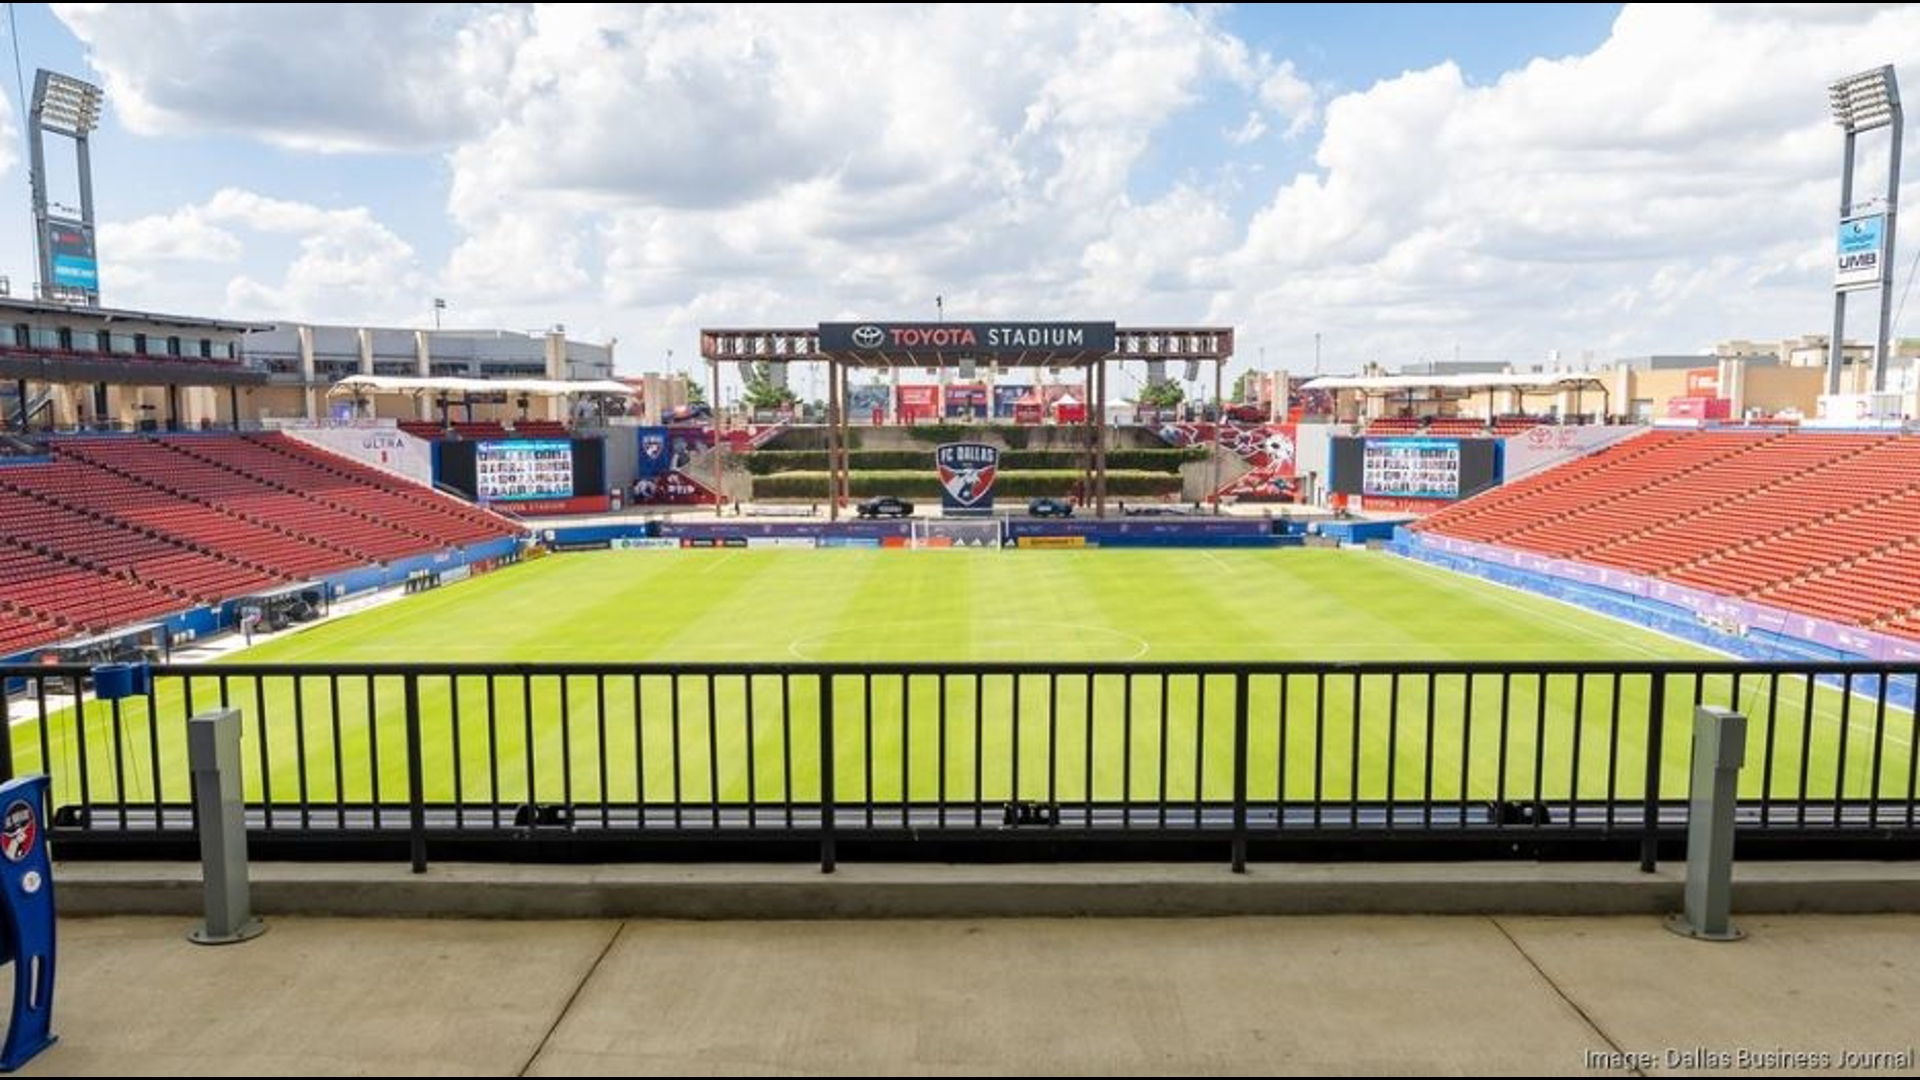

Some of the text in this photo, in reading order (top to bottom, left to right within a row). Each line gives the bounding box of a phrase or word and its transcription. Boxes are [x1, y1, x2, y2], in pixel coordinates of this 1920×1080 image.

[1839, 253, 1876, 269] UMB
[891, 328, 1084, 346] TOYOTA STADIUM
[363, 438, 404, 449] ULTRA
[940, 446, 994, 463] FC DALLAS
